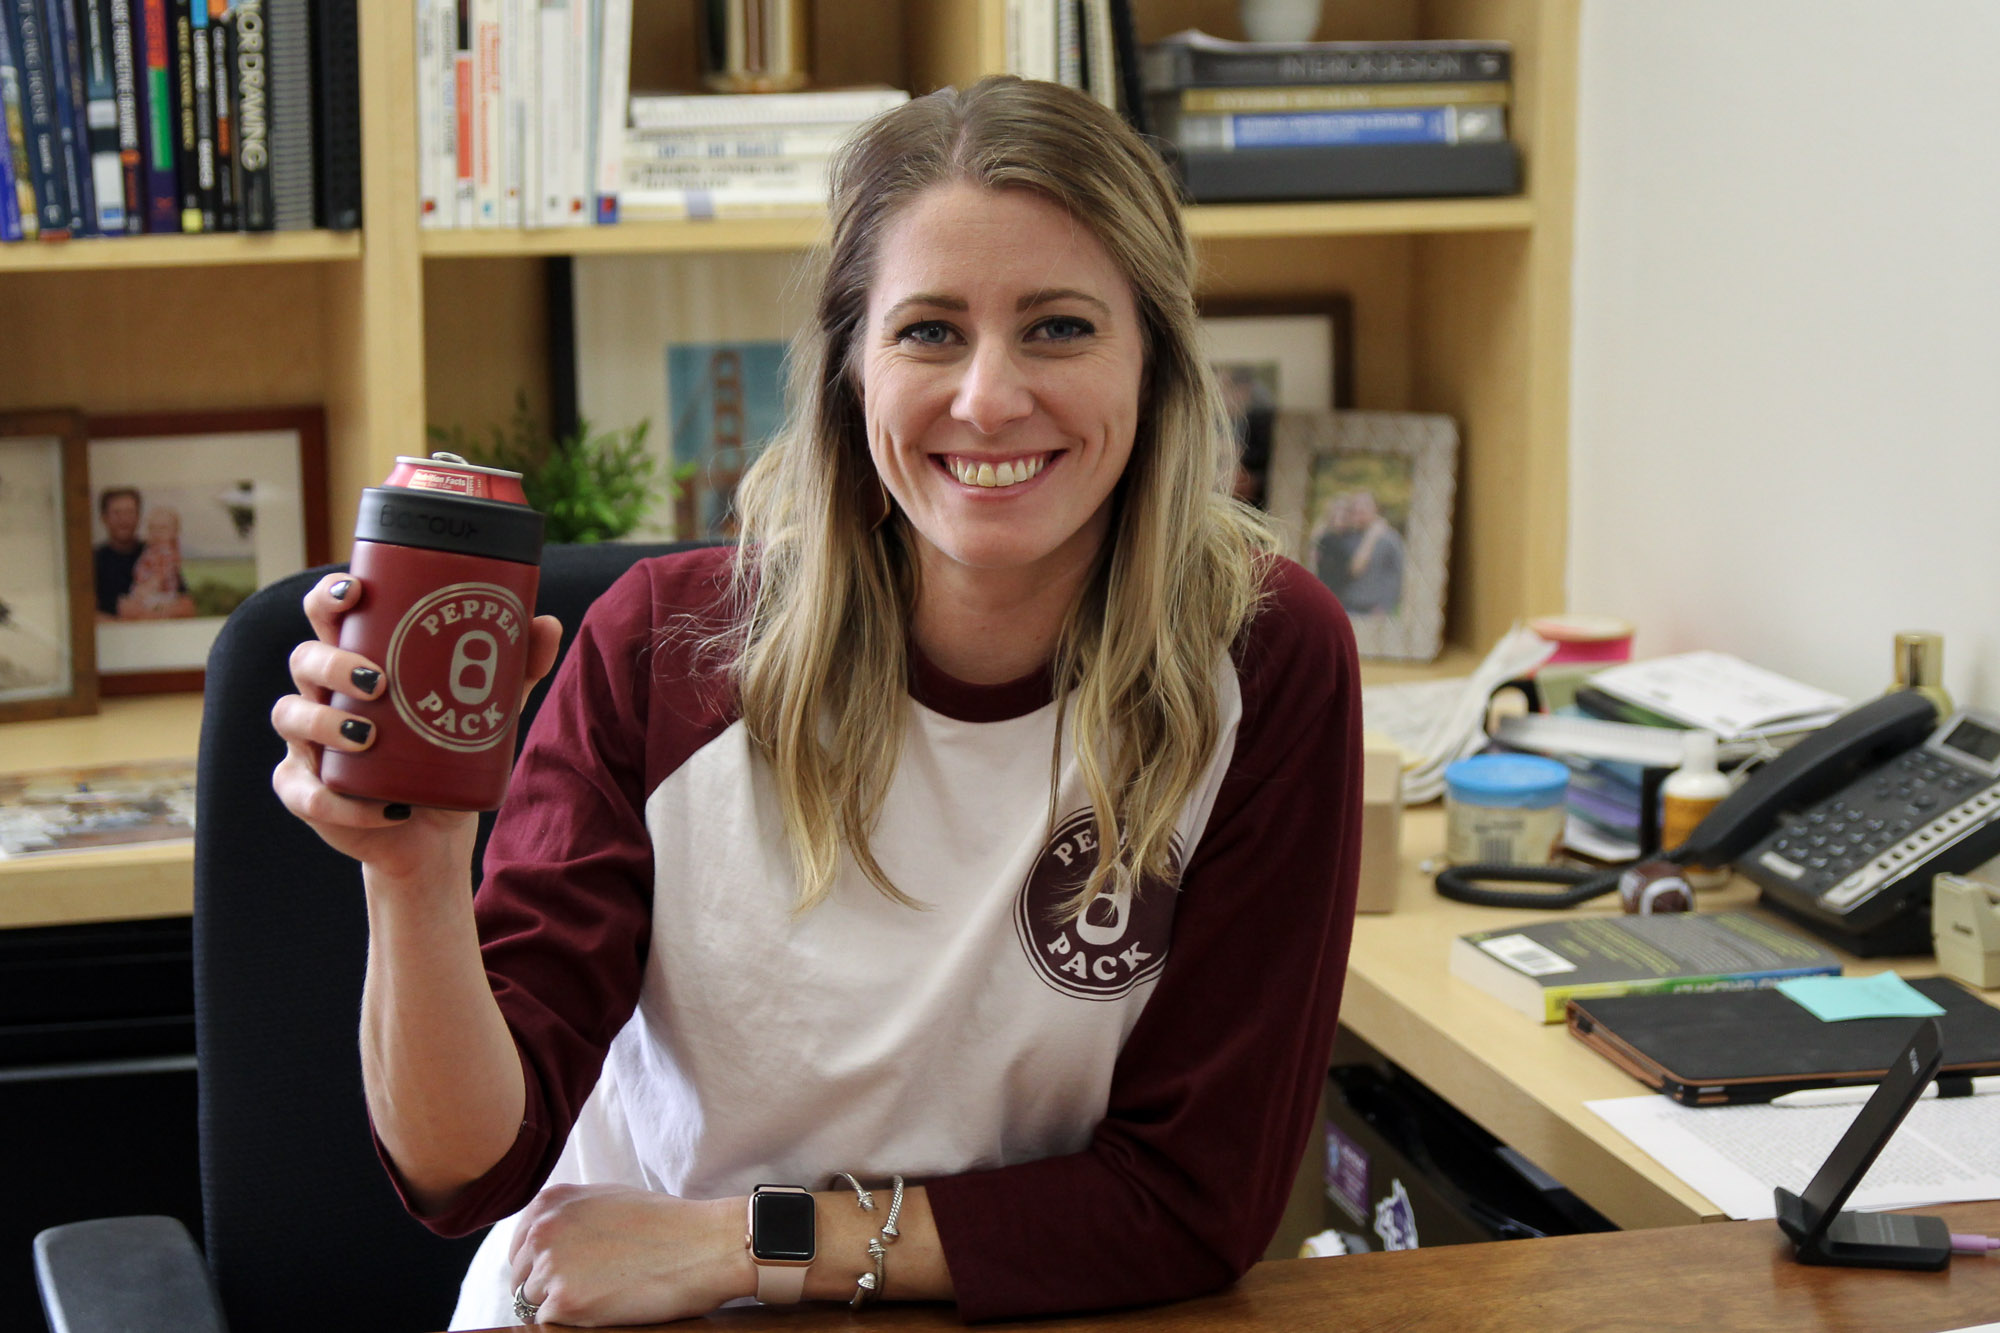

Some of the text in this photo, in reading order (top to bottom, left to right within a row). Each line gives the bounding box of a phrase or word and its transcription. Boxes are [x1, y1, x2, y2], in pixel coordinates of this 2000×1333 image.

[238, 52, 268, 172] DRAWING
[444, 476, 467, 487] Facts
[420, 599, 520, 645] PEPPER
[416, 690, 505, 735] PACK
[1046, 931, 1152, 981] PACK
